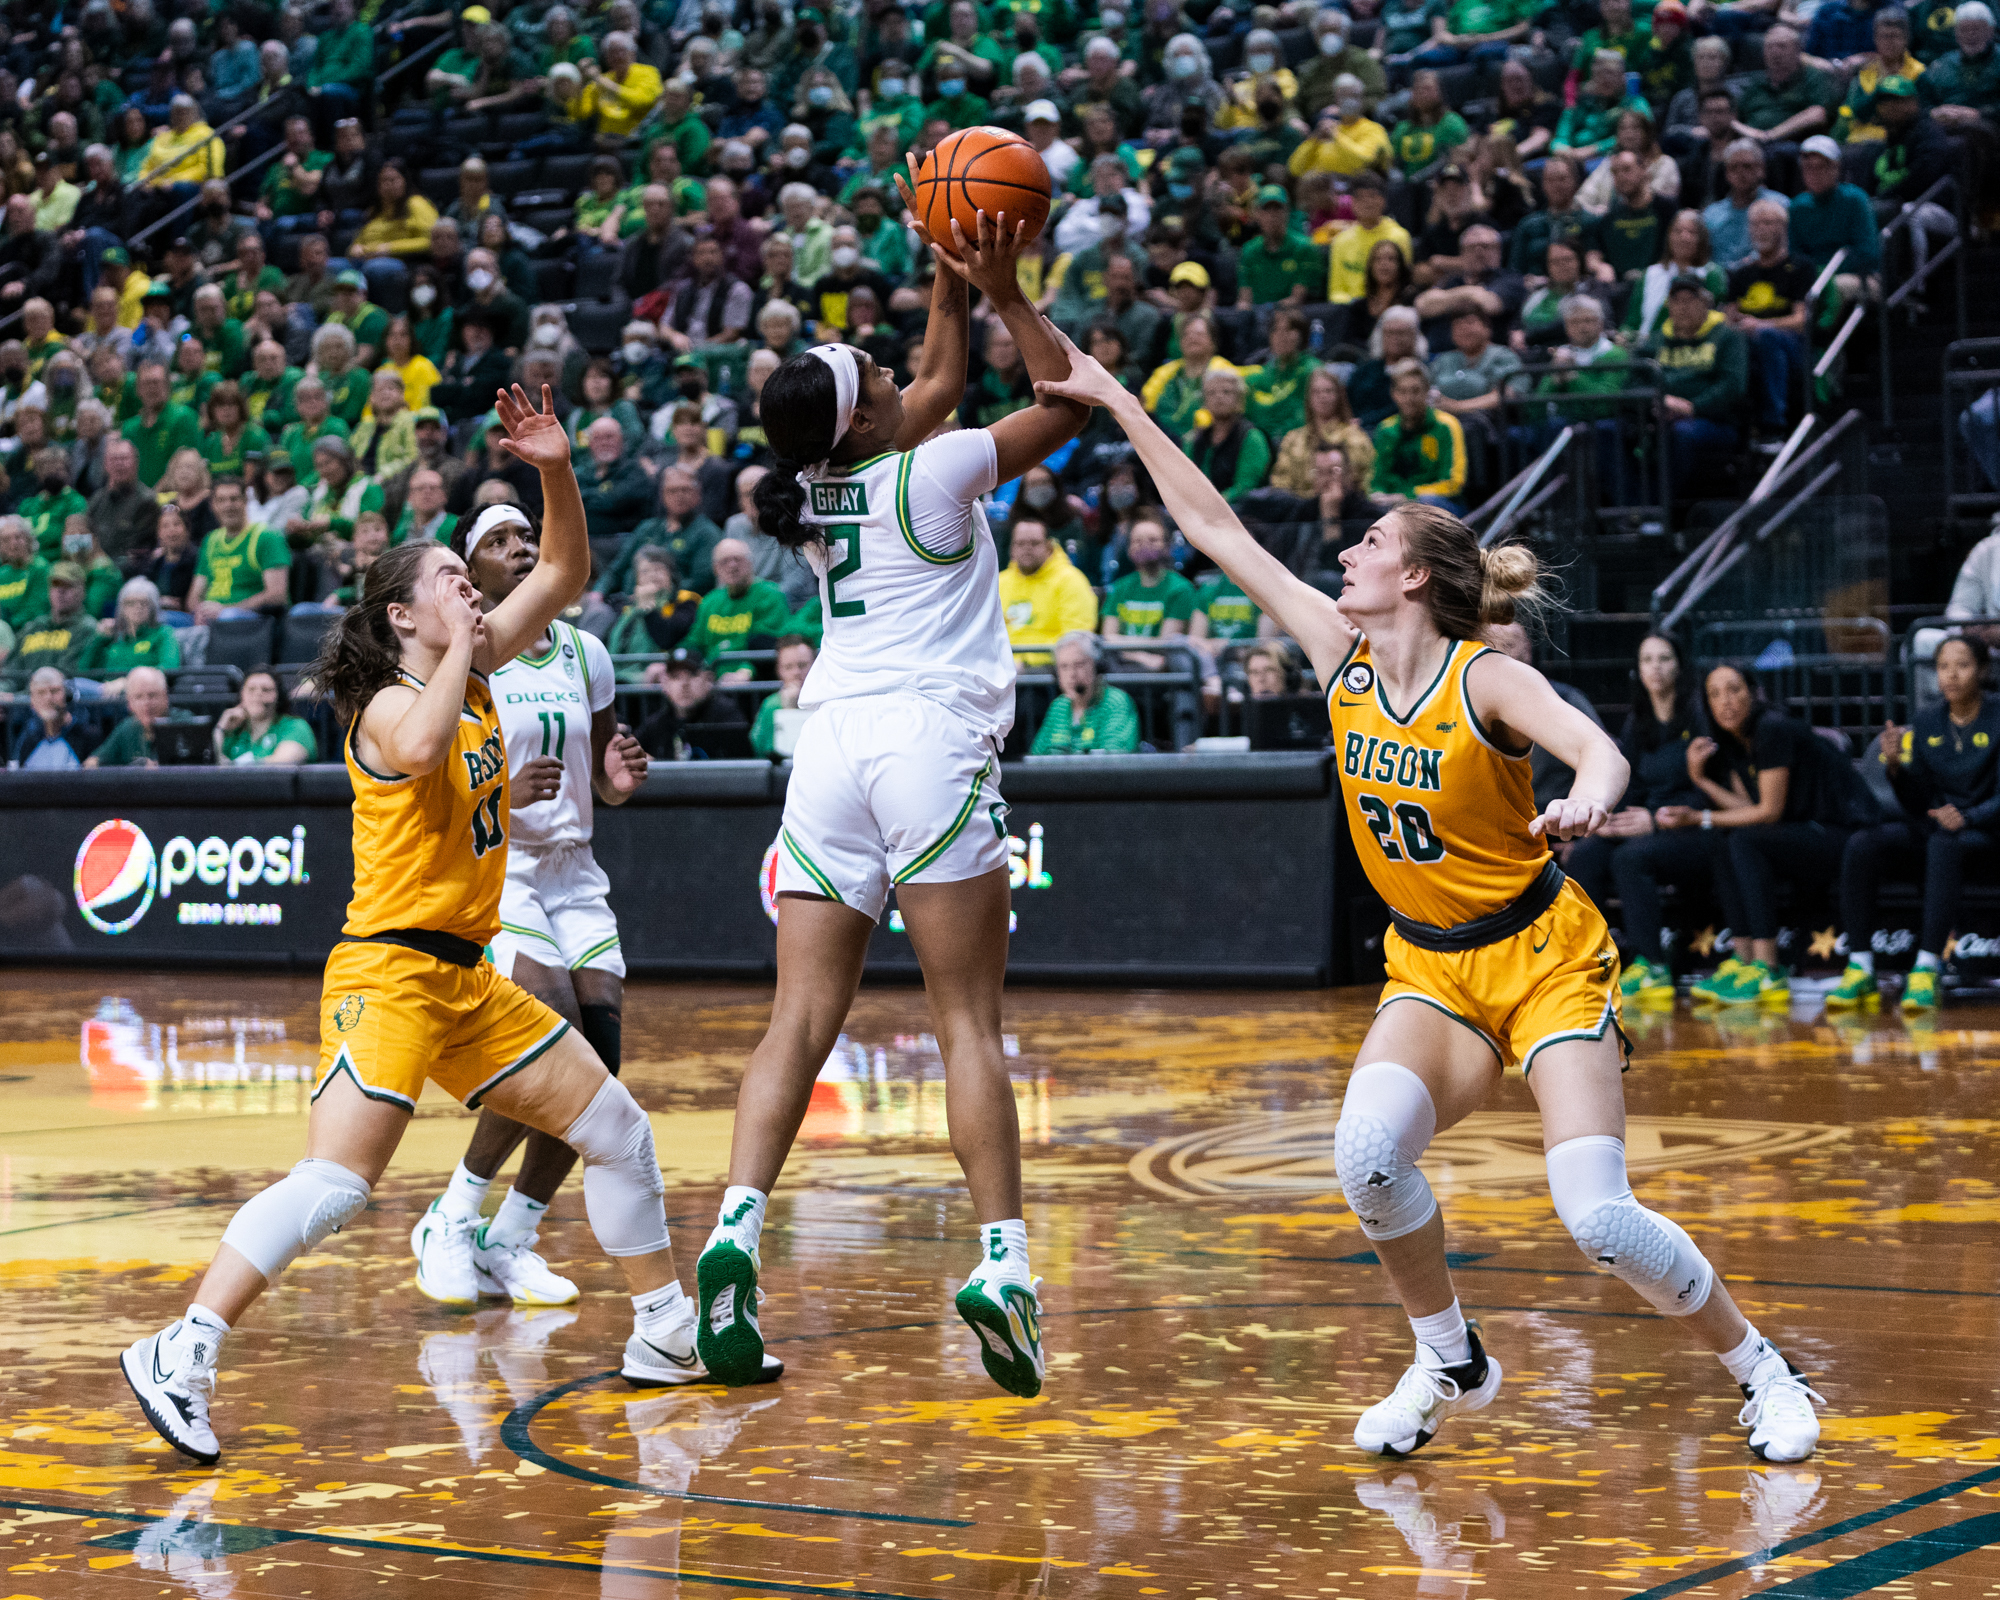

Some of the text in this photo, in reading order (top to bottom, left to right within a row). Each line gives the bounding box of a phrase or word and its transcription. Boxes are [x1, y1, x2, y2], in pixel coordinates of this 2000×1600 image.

[815, 487, 860, 511] GRAY
[825, 523, 867, 618] 2
[506, 691, 580, 704] DUCKS
[538, 712, 566, 761] 11
[1345, 729, 1444, 791] BISON
[1357, 792, 1447, 864] 20
[159, 824, 308, 899] pepsi
